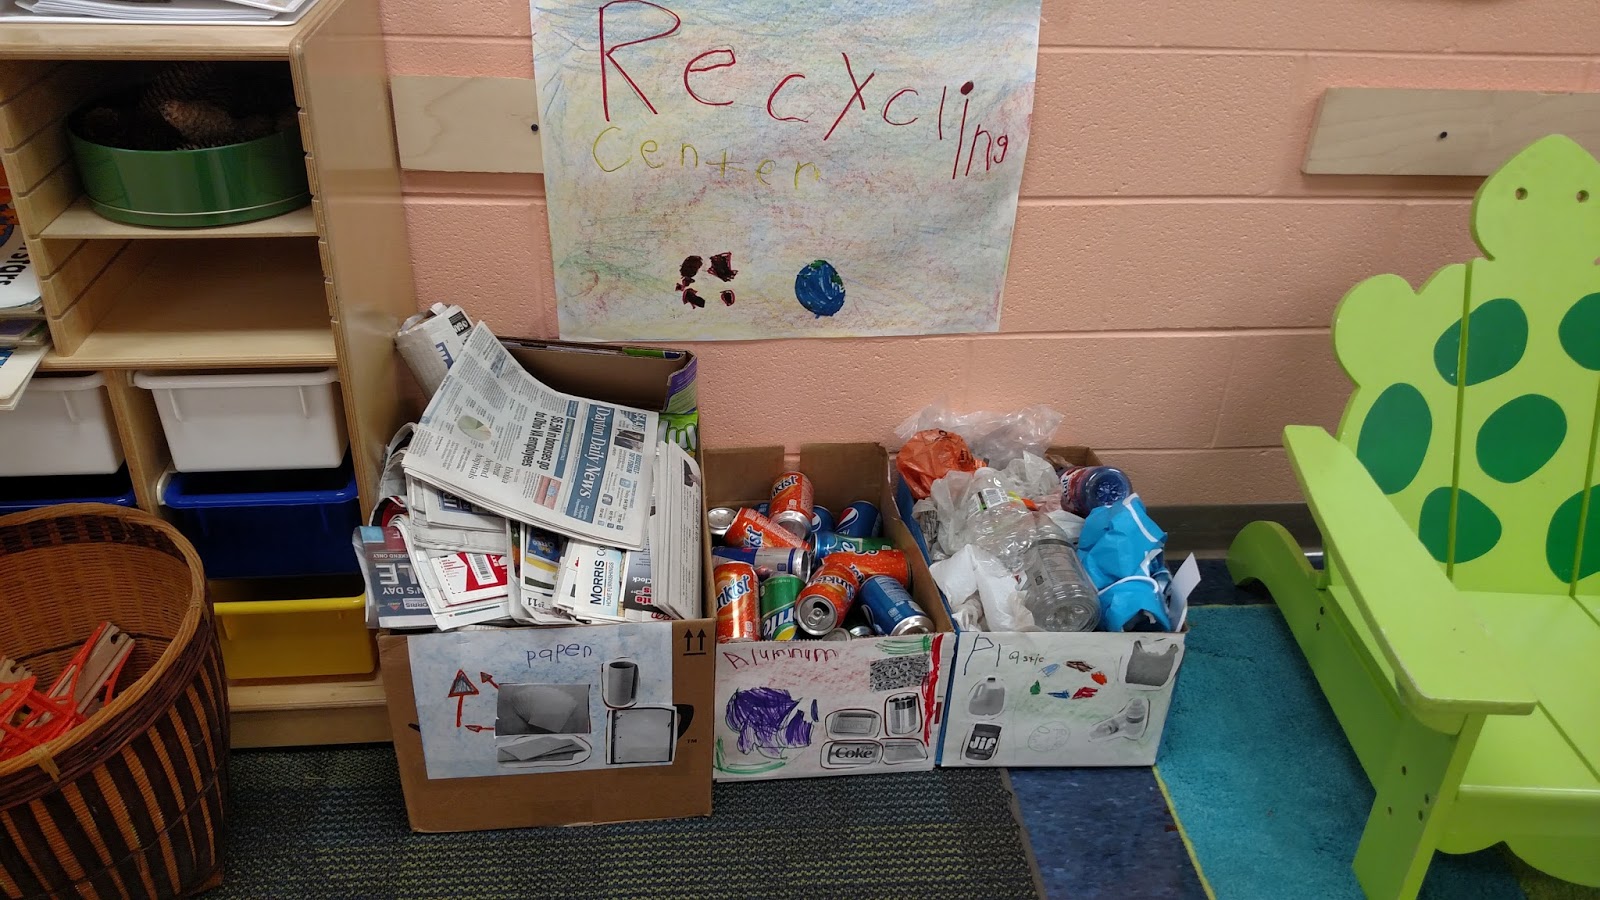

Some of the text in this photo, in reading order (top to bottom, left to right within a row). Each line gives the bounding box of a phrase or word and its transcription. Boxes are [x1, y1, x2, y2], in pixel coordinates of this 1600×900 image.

[592, 406, 611, 437] Dayton
[521, 437, 539, 468] employees
[541, 437, 560, 462] bonuses
[584, 436, 606, 466] Daily
[536, 460, 550, 471] go
[579, 463, 601, 499] News
[375, 563, 418, 585] LE
[590, 560, 605, 606] MORRIS
[606, 561, 615, 593] FURNISHINGS
[382, 586, 404, 595] DAY
[717, 573, 751, 614] nkist
[722, 647, 841, 670] Aluminum
[963, 633, 1046, 676] Plastic
[834, 747, 874, 760] Coke
[969, 736, 998, 753] Jif
